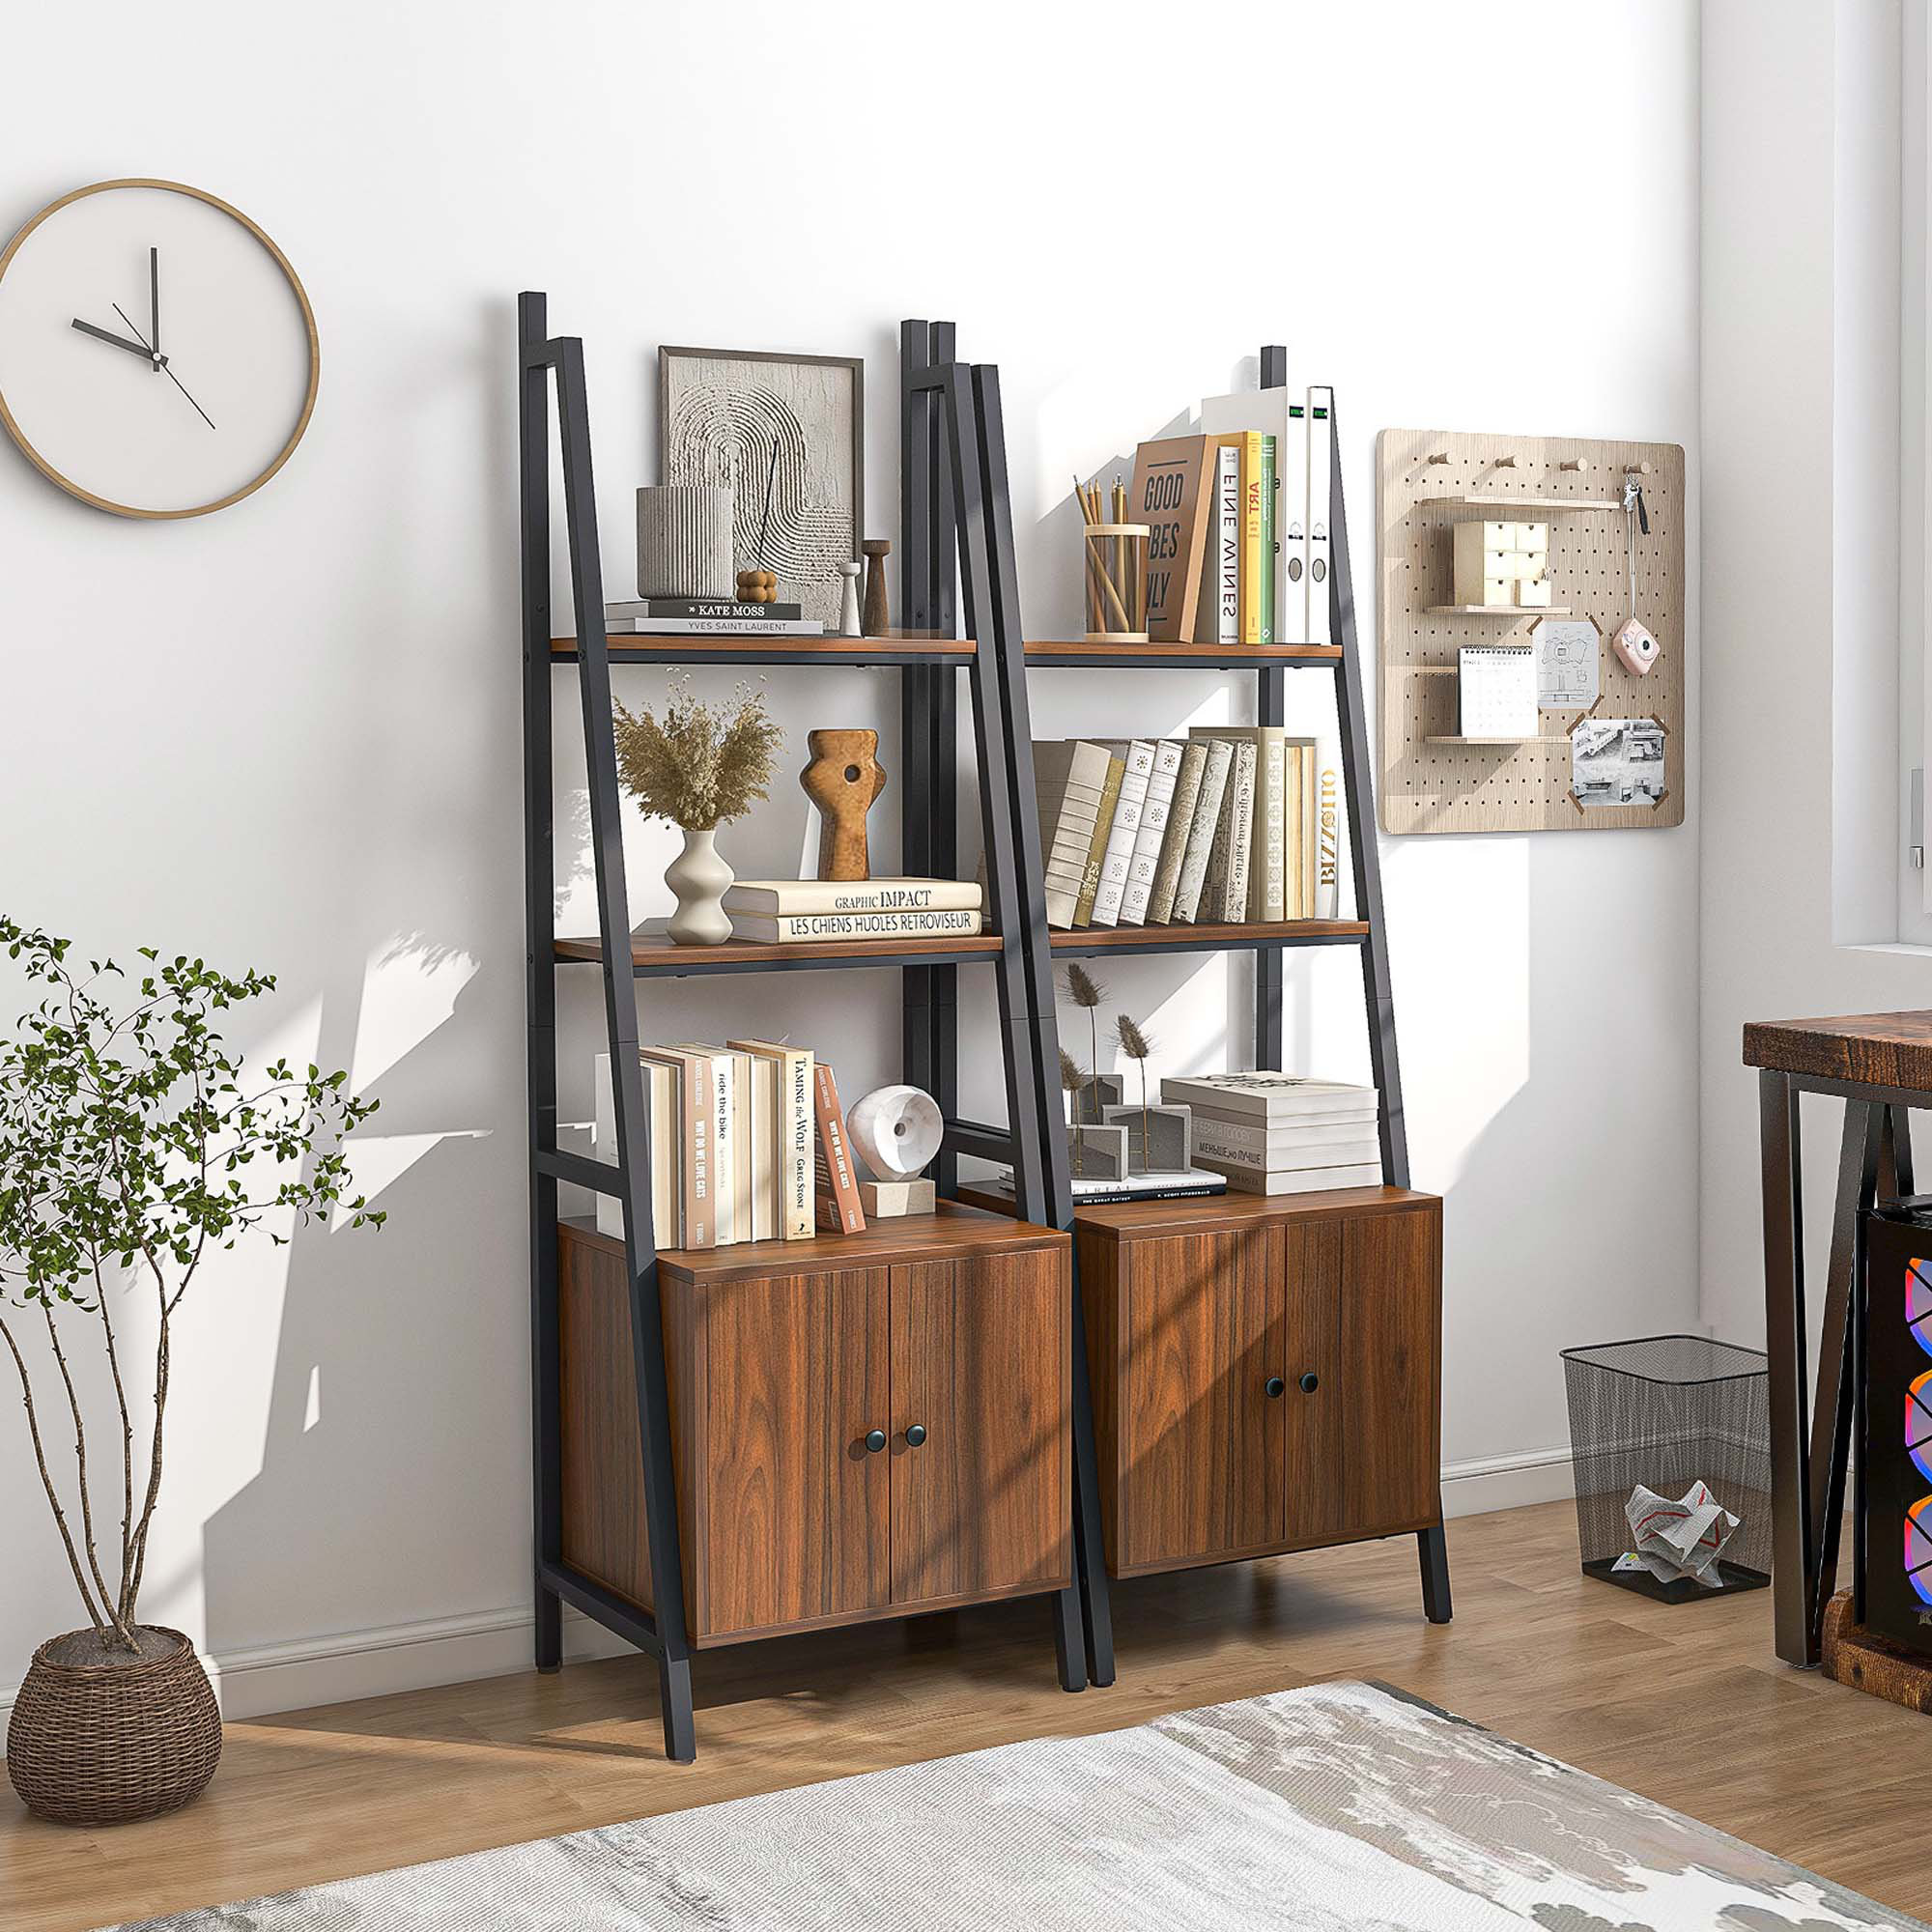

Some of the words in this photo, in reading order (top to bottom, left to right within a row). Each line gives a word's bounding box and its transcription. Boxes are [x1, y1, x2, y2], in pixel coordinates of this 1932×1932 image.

[1144, 472, 1184, 513] GOOD
[1150, 522, 1180, 560] BES
[697, 605, 730, 616] KATE
[732, 605, 766, 617] MOSS
[688, 621, 713, 631] YVES
[715, 621, 743, 632] SAINT
[745, 622, 787, 632] LAURENT
[835, 895, 879, 910] GRAPHIC
[880, 889, 932, 909] IMPACT
[790, 918, 810, 935] LES
[811, 916, 852, 934] CHIENS
[855, 914, 898, 933] HUOLES
[900, 912, 972, 931] RETROVISEUR
[718, 1073, 726, 1094] ride
[795, 1057, 808, 1104] TAMING
[718, 1096, 726, 1115] the
[795, 1106, 805, 1119] the
[718, 1117, 726, 1140] bike
[795, 1119, 808, 1152] WOLF
[695, 1162, 706, 1179] LOVE
[796, 1158, 806, 1182] GREG
[696, 1180, 706, 1199] CATS
[796, 1181, 806, 1209] STONE
